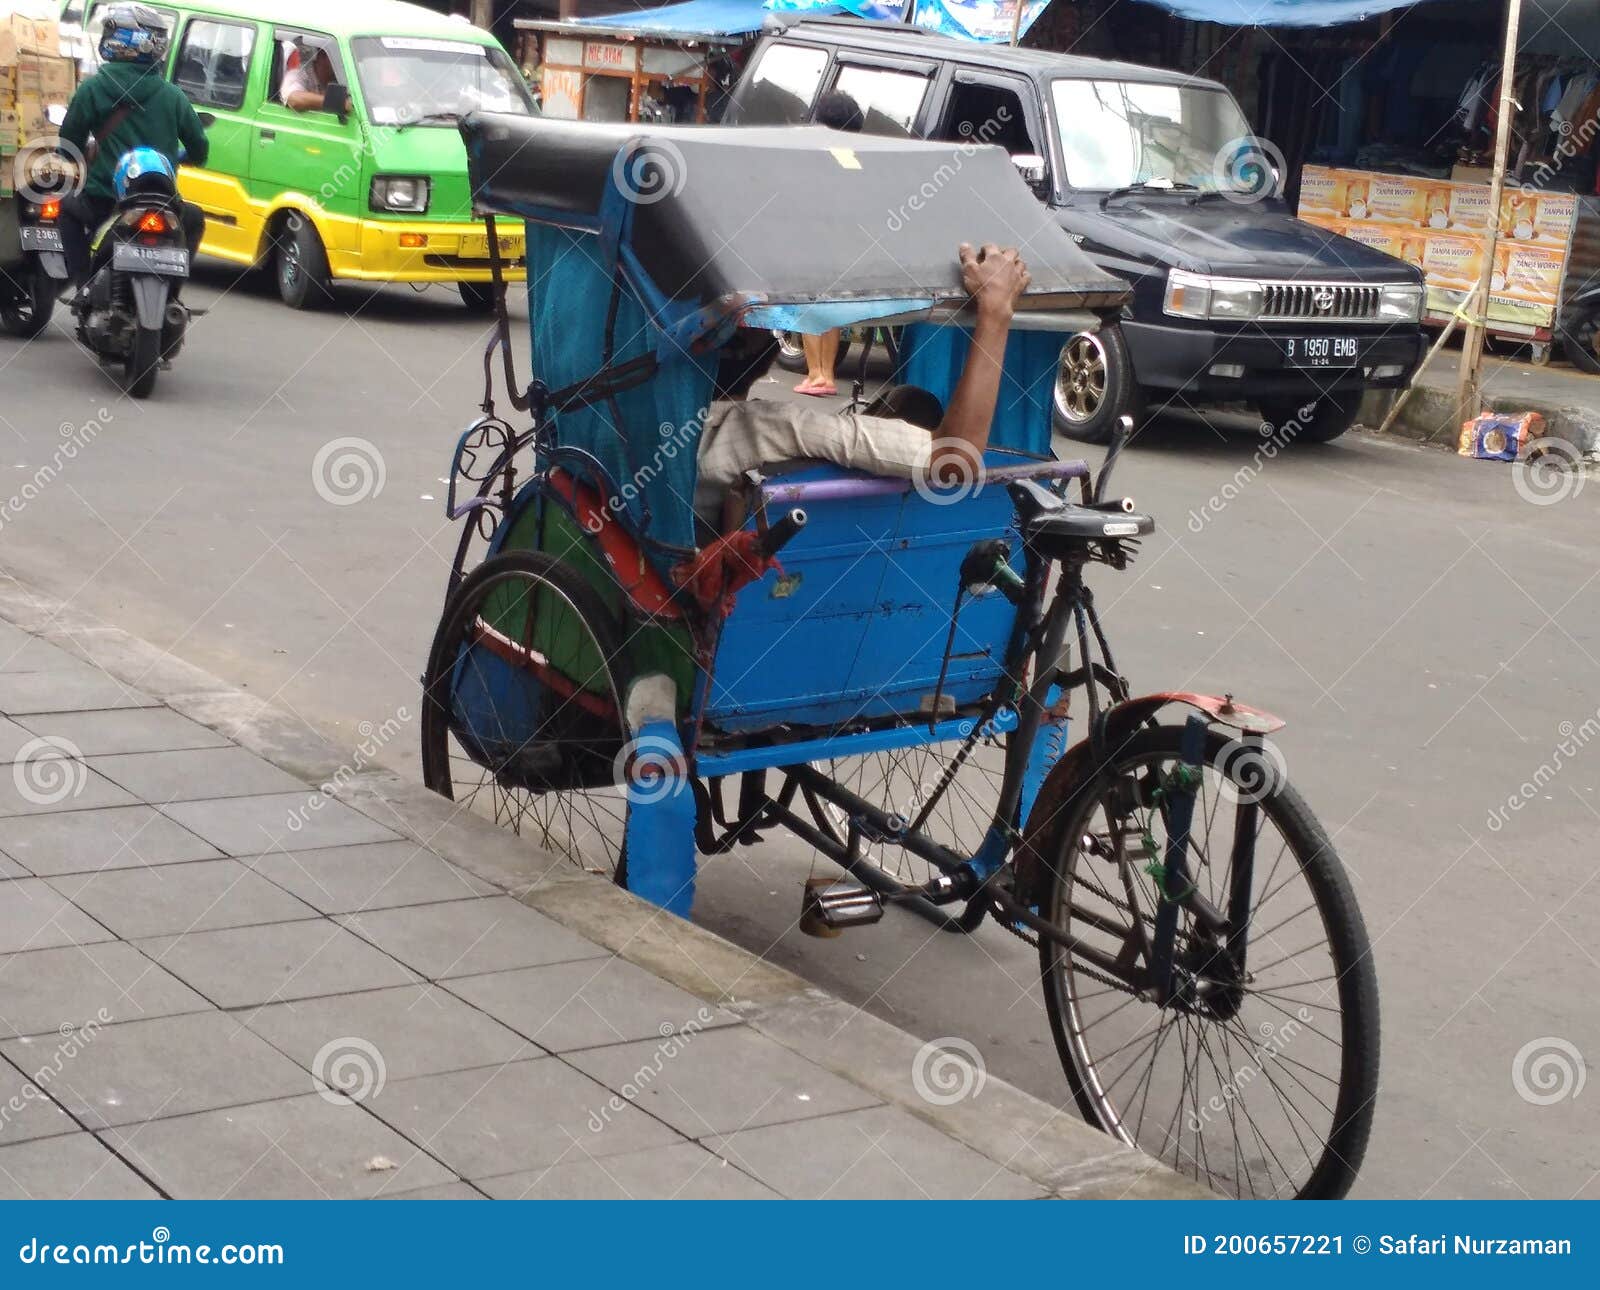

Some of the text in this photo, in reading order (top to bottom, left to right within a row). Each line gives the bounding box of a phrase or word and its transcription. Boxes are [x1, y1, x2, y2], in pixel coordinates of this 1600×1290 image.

[588, 45, 602, 61] MIE
[1431, 247, 1451, 256] TANPA
[1537, 261, 1561, 269] WORRY
[1288, 338, 1356, 357] B 1950 EMB
